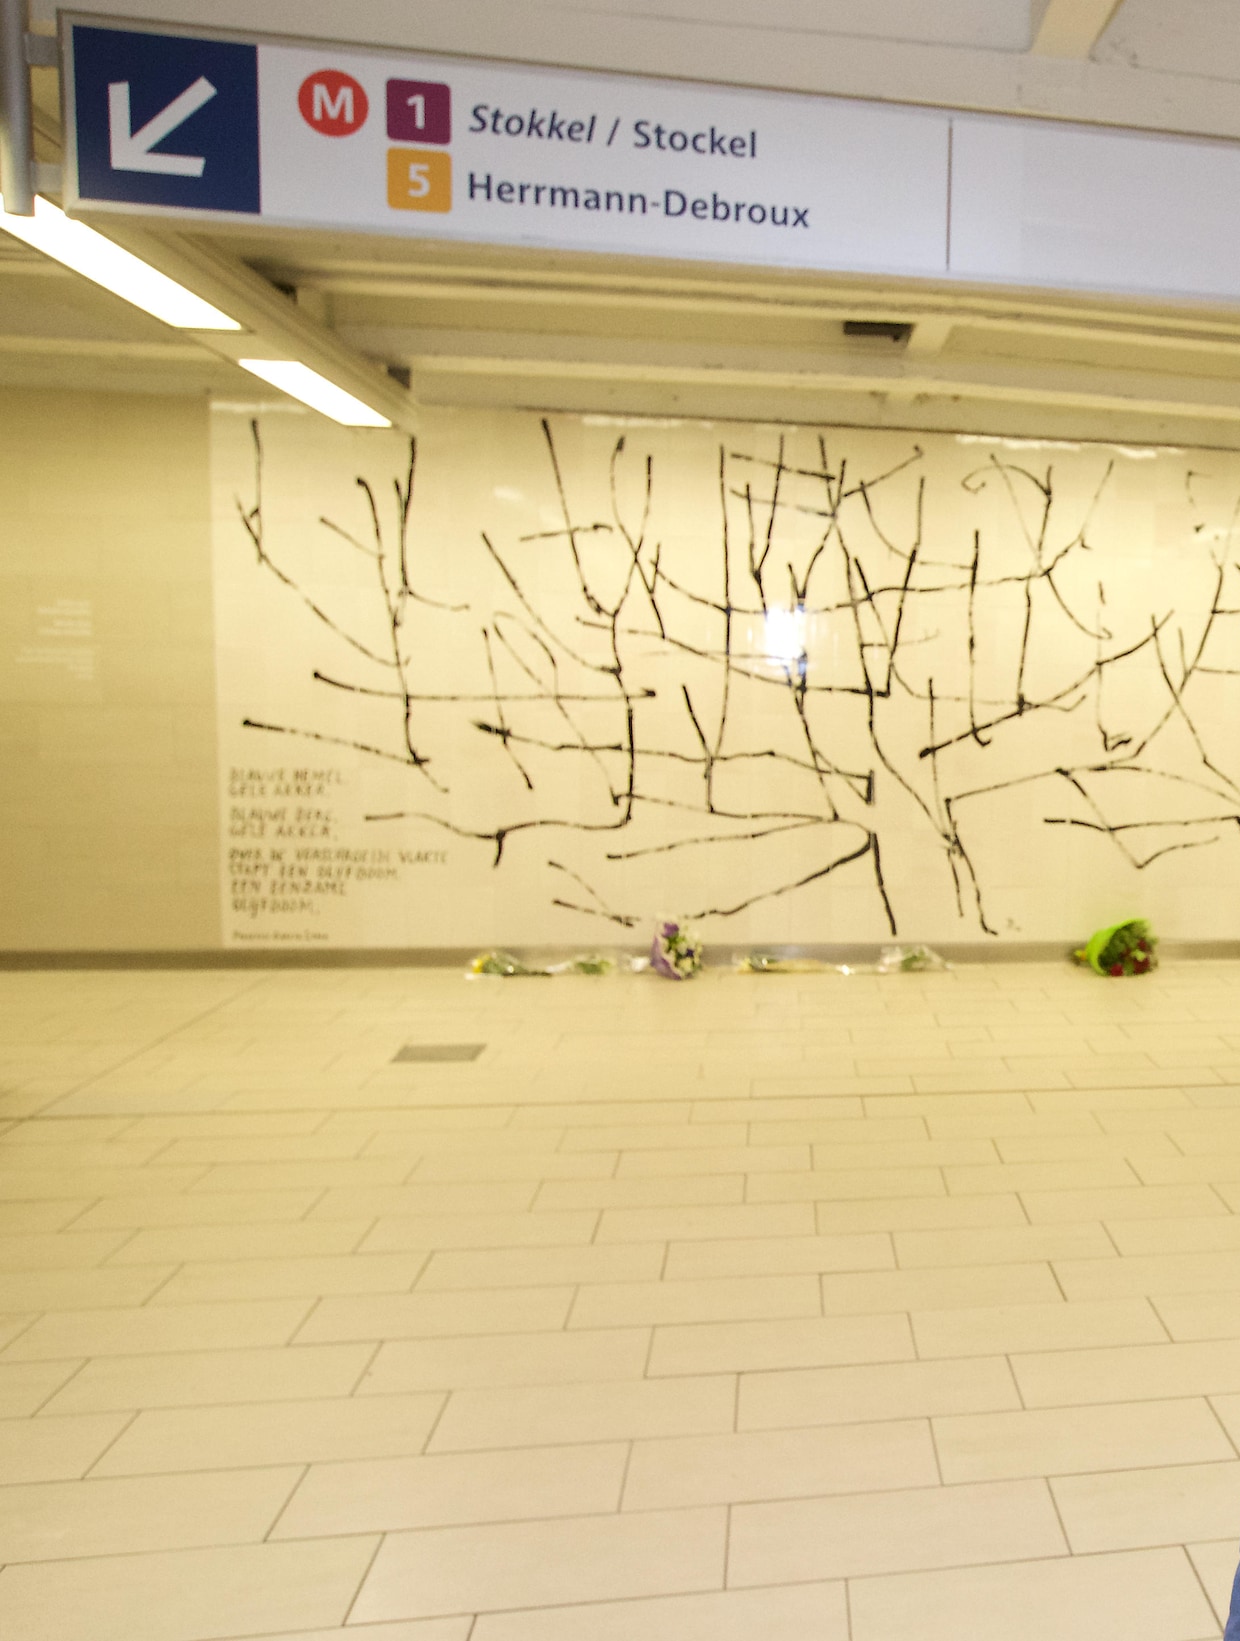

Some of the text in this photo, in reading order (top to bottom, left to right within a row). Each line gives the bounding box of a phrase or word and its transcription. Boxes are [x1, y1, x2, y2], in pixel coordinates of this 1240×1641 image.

[312, 83, 757, 158] M 1 Stokkel / Stockel
[407, 163, 810, 229] 5 Herrmann-Debroux
